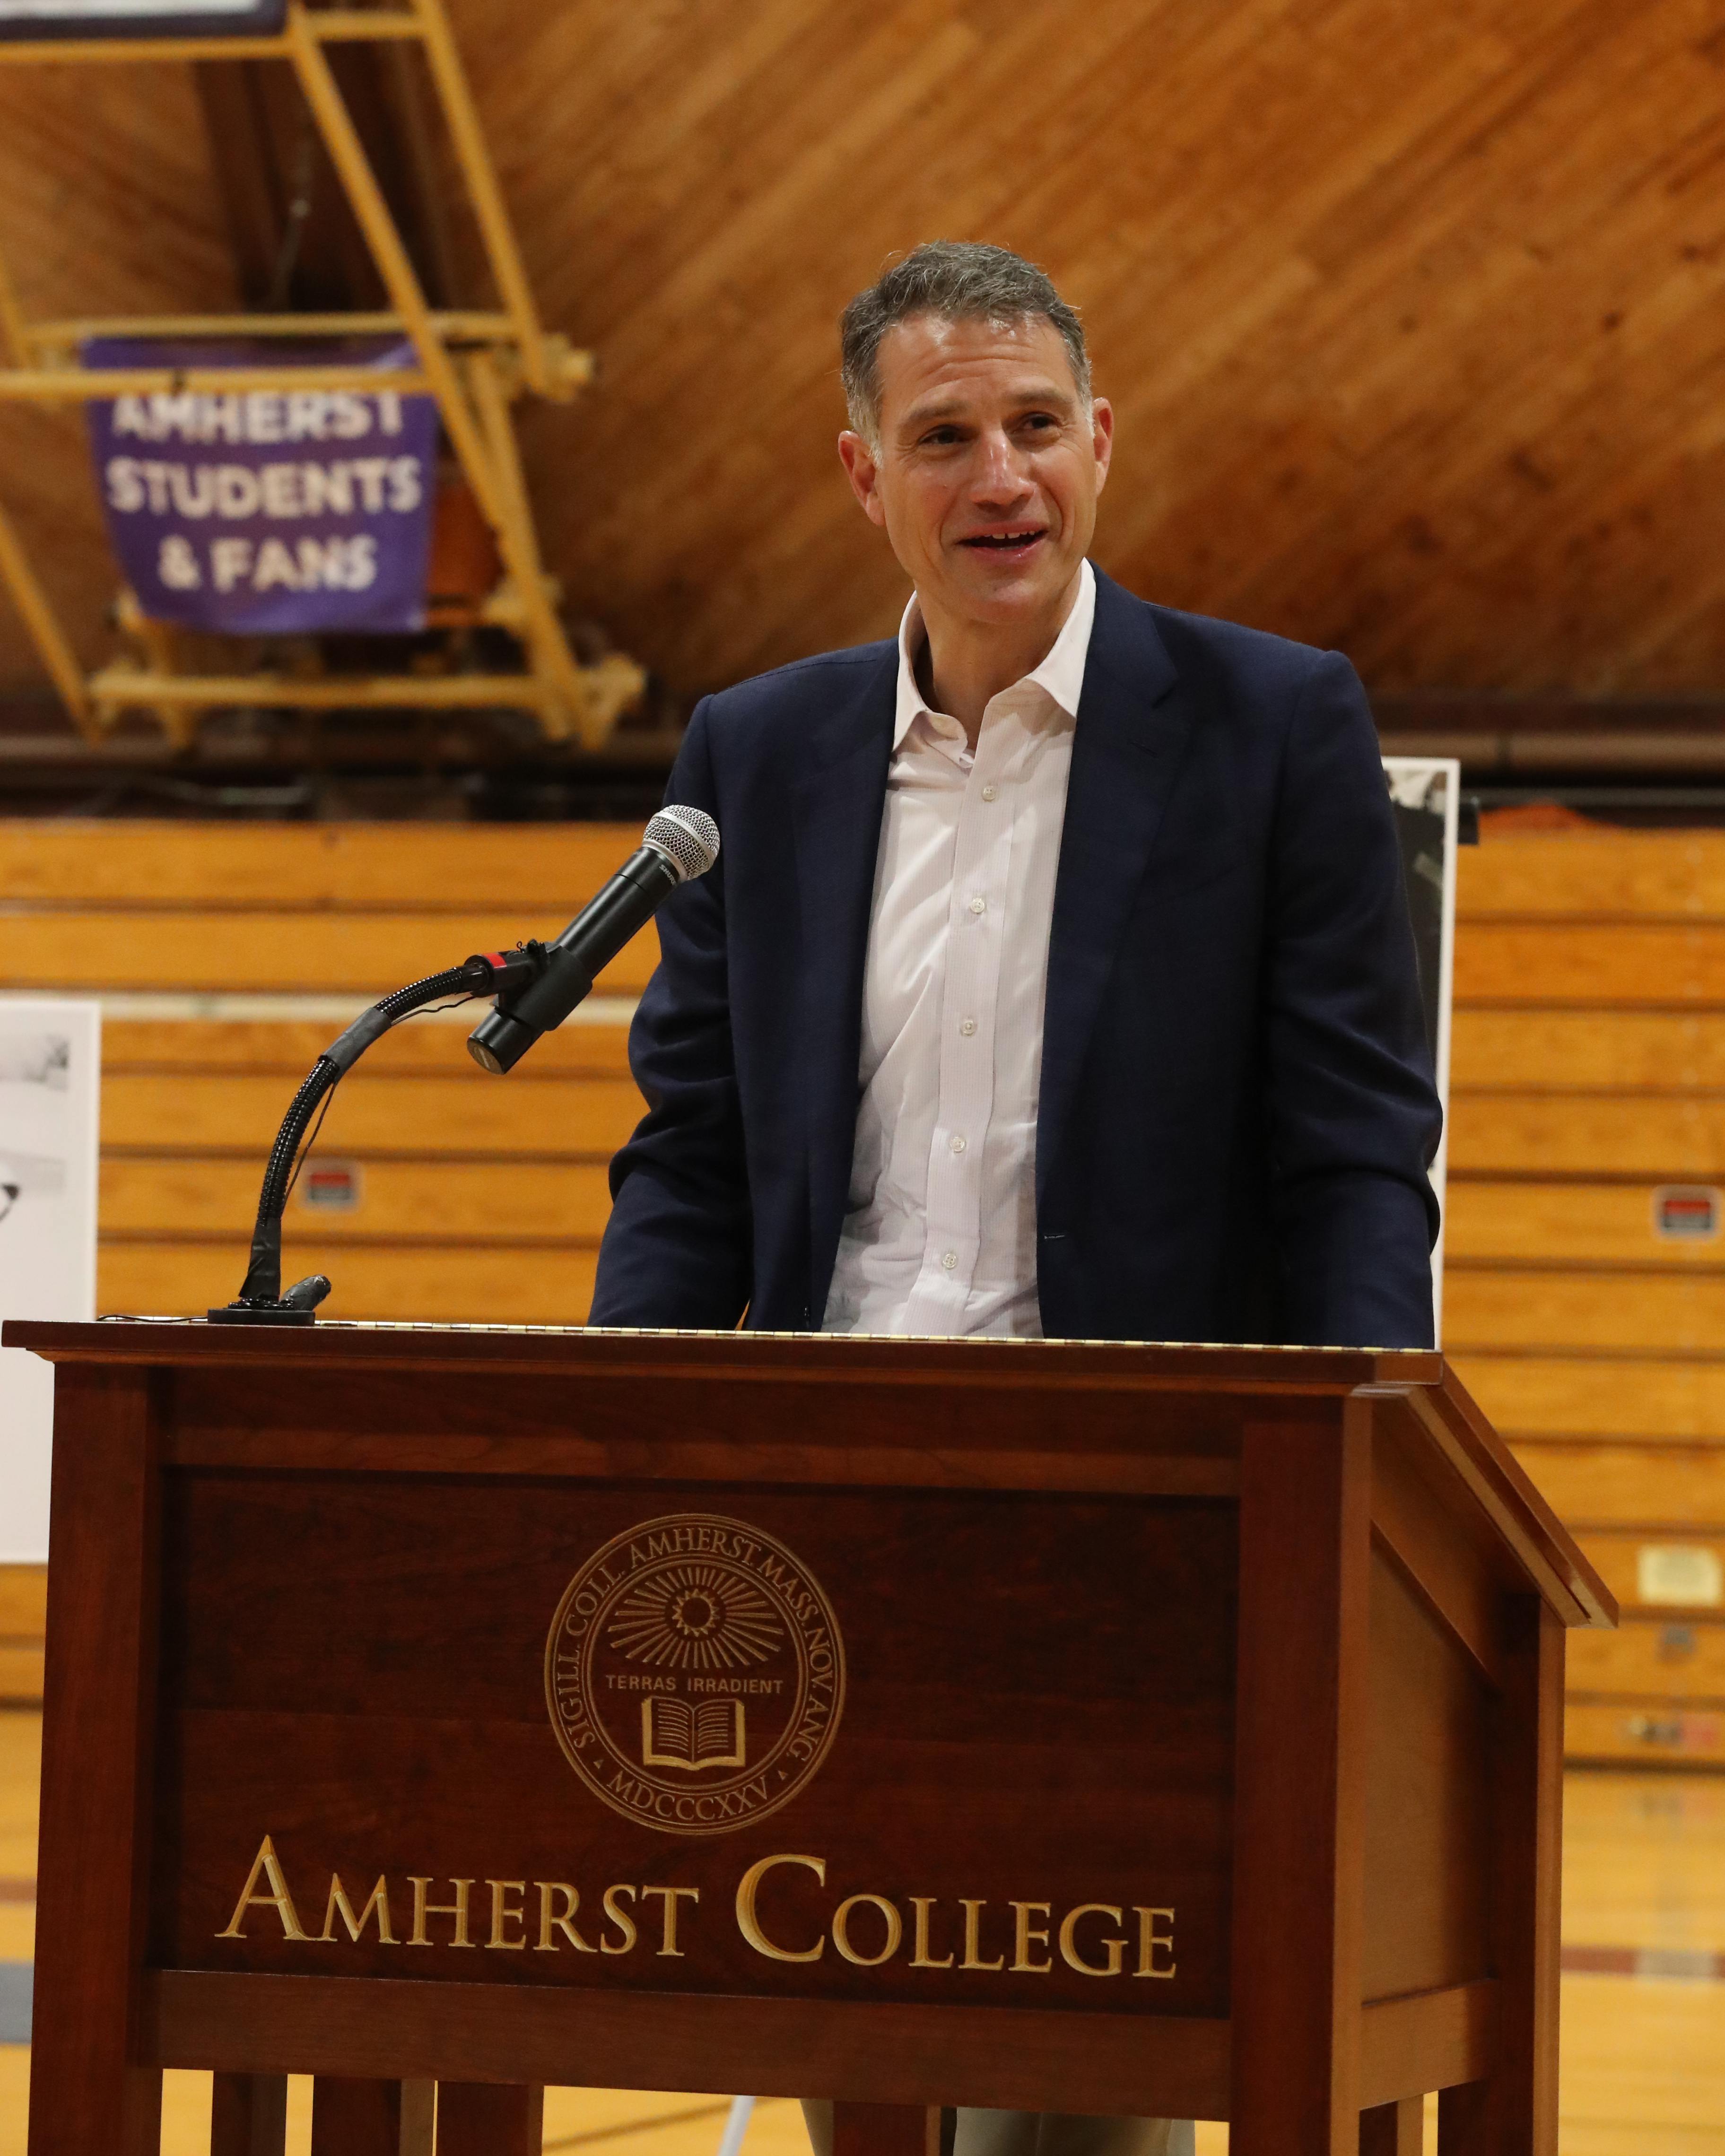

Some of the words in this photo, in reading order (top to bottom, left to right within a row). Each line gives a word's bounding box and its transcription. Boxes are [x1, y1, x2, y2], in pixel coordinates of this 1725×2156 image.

[107, 455, 422, 518] STUDENTS
[158, 534, 200, 591] &
[209, 533, 377, 593] FANS
[659, 864, 677, 886] SHURE
[605, 1674, 677, 1691] TERRAS
[687, 1678, 784, 1694] IRRADIENT
[606, 1770, 767, 1820] MDCCCXXV
[214, 1834, 699, 1957] AMHERST
[735, 1853, 1176, 1979] COLLEGE
